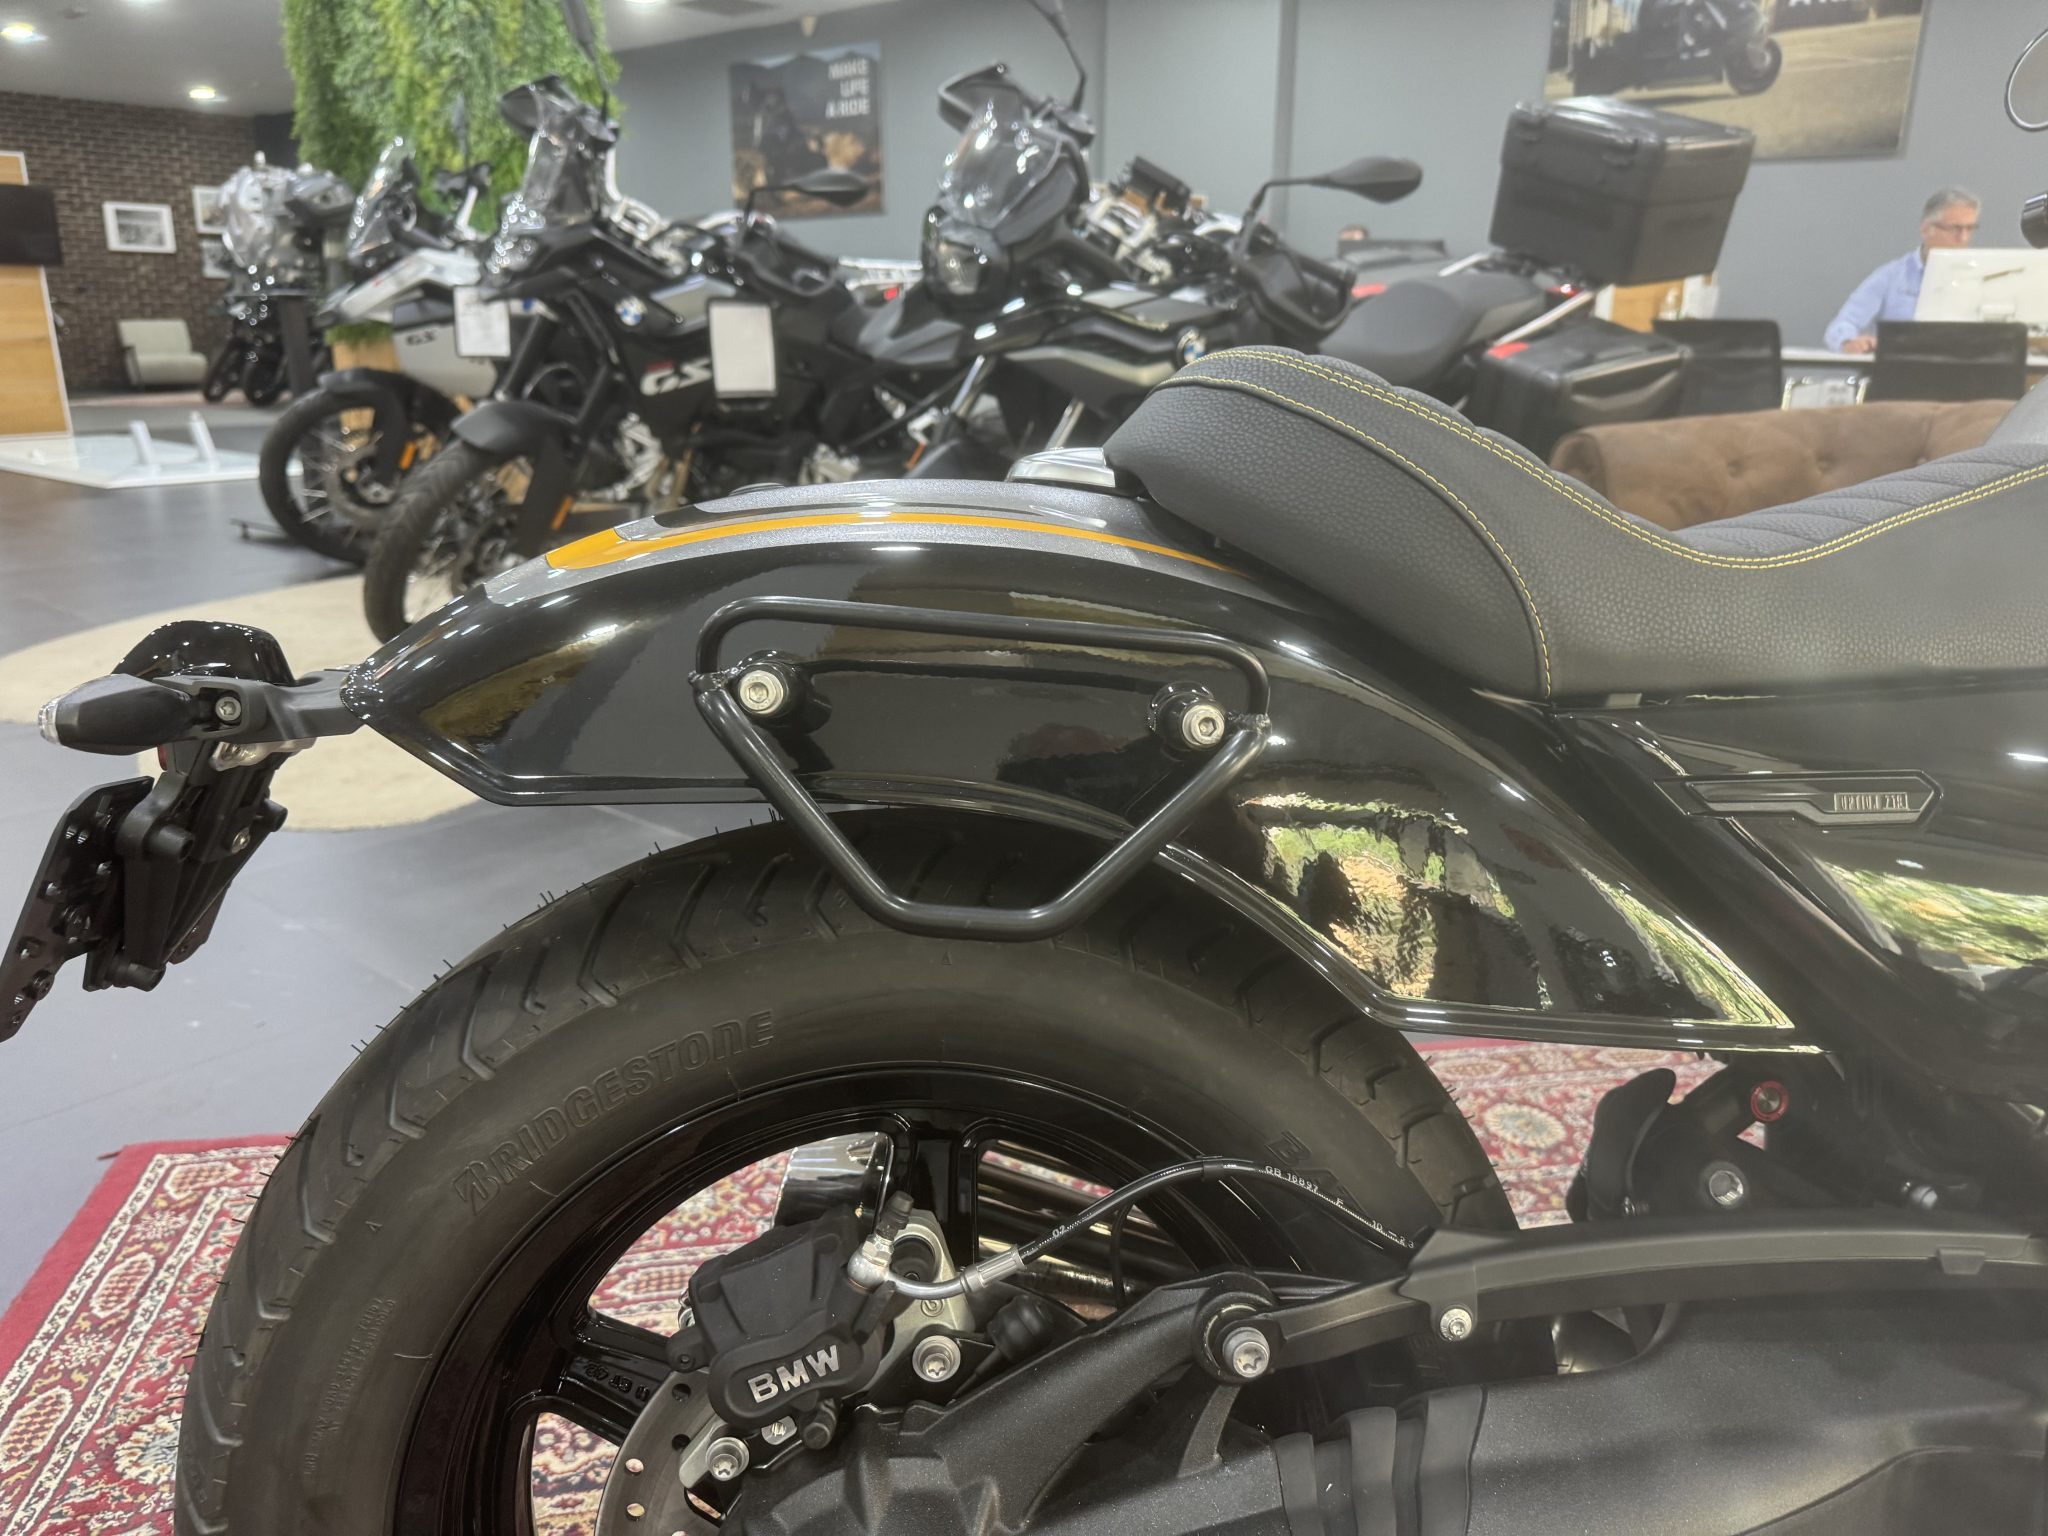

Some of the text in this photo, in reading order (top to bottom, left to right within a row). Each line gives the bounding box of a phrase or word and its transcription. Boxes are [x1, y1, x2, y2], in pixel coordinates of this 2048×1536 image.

[640, 358, 712, 396] GS
[453, 1008, 774, 1215] BRIDGESTONE
[748, 1345, 839, 1403] BMW
